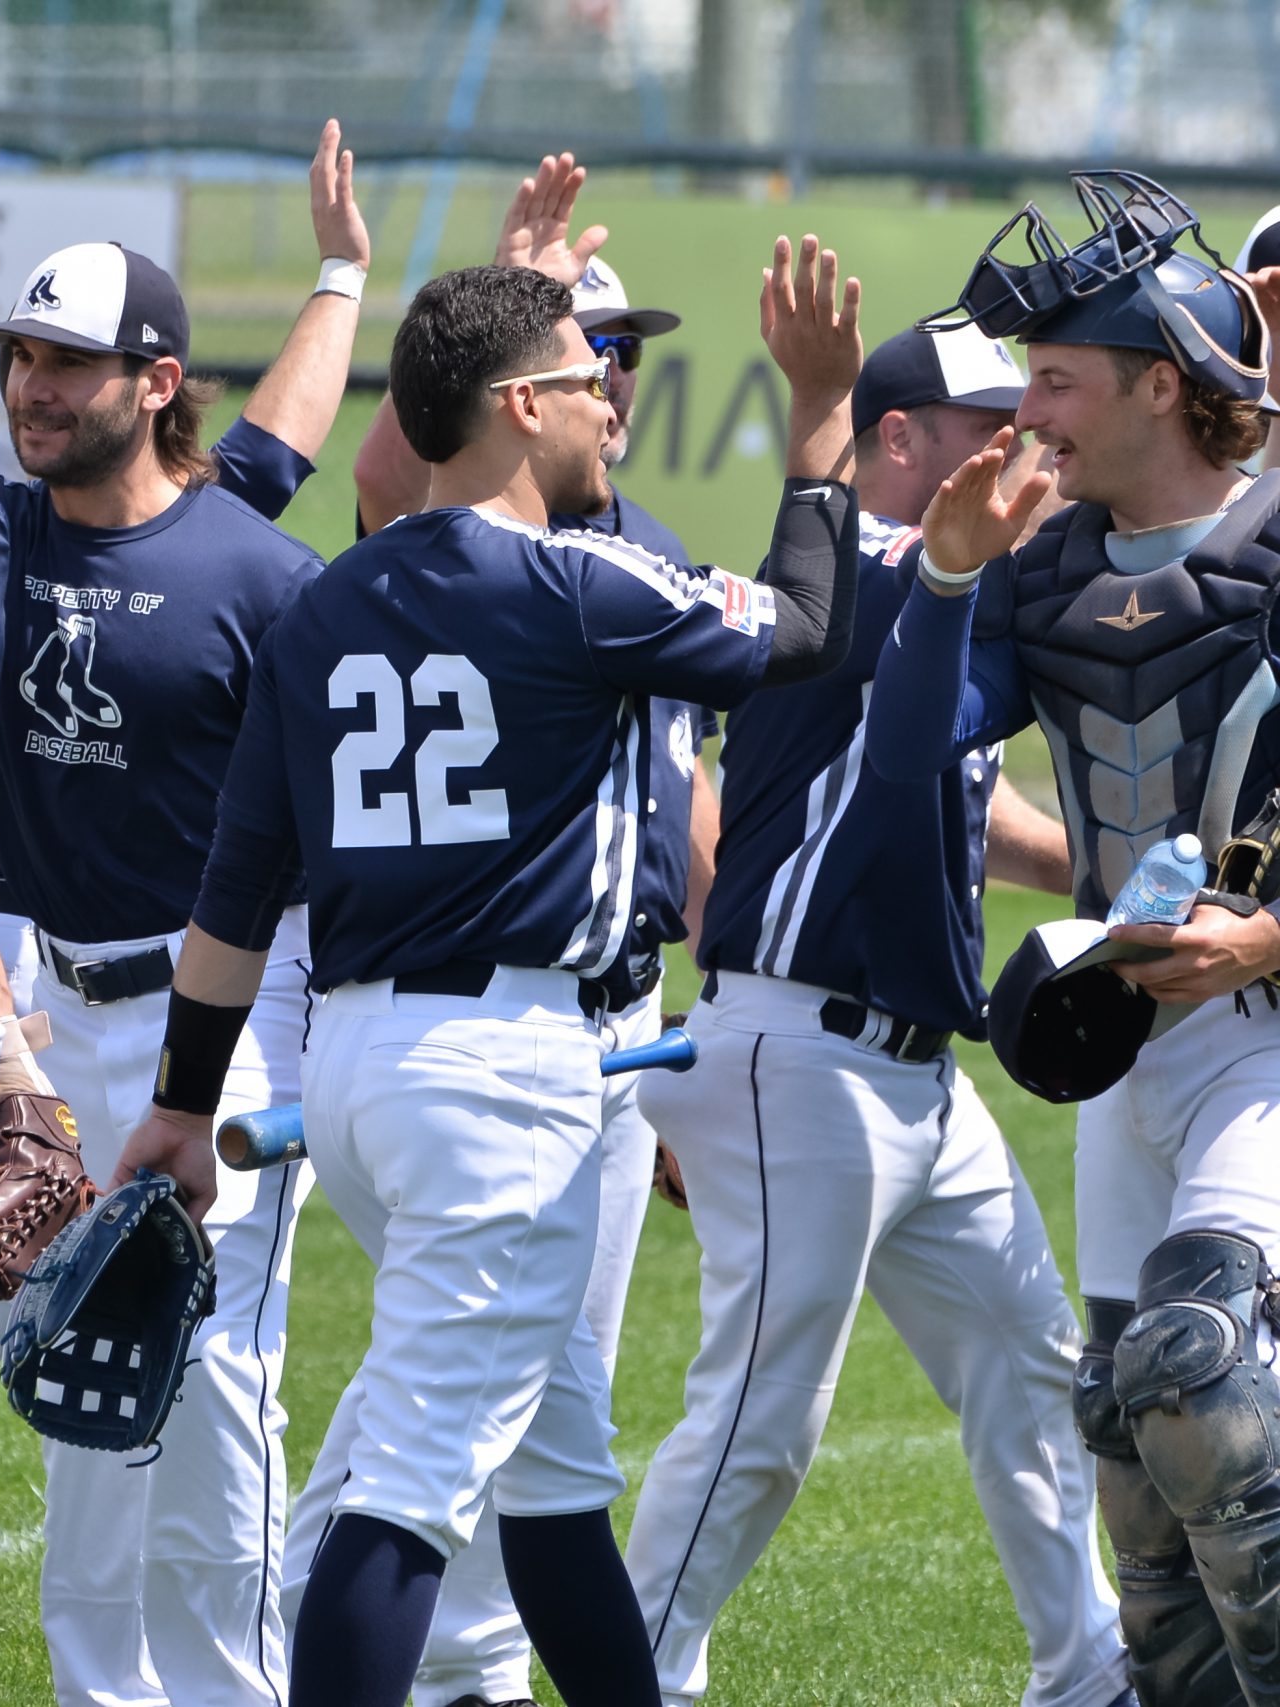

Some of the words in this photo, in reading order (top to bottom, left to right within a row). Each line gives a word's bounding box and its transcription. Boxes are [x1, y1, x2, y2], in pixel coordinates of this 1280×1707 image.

[128, 591, 164, 614] OF
[24, 729, 127, 769] BASEBALL
[328, 654, 510, 848] 22
